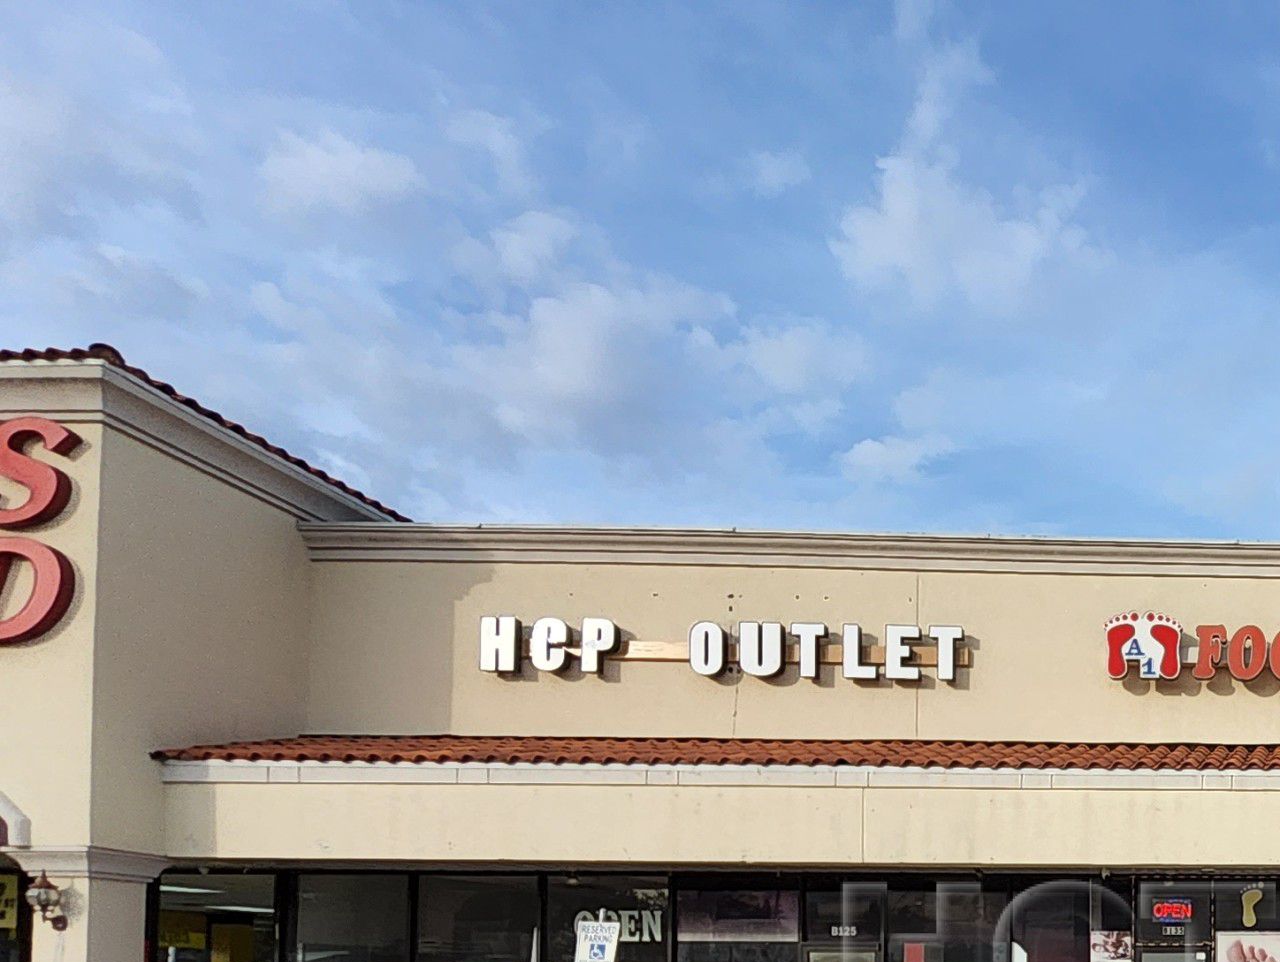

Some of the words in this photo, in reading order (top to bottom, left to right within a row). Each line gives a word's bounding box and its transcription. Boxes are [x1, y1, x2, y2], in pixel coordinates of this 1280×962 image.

[688, 620, 964, 681] OUTLET
[1124, 639, 1146, 656] A
[1152, 903, 1192, 920] OPEN
[581, 924, 617, 934] RESERVED
[584, 934, 613, 943] PARKING
